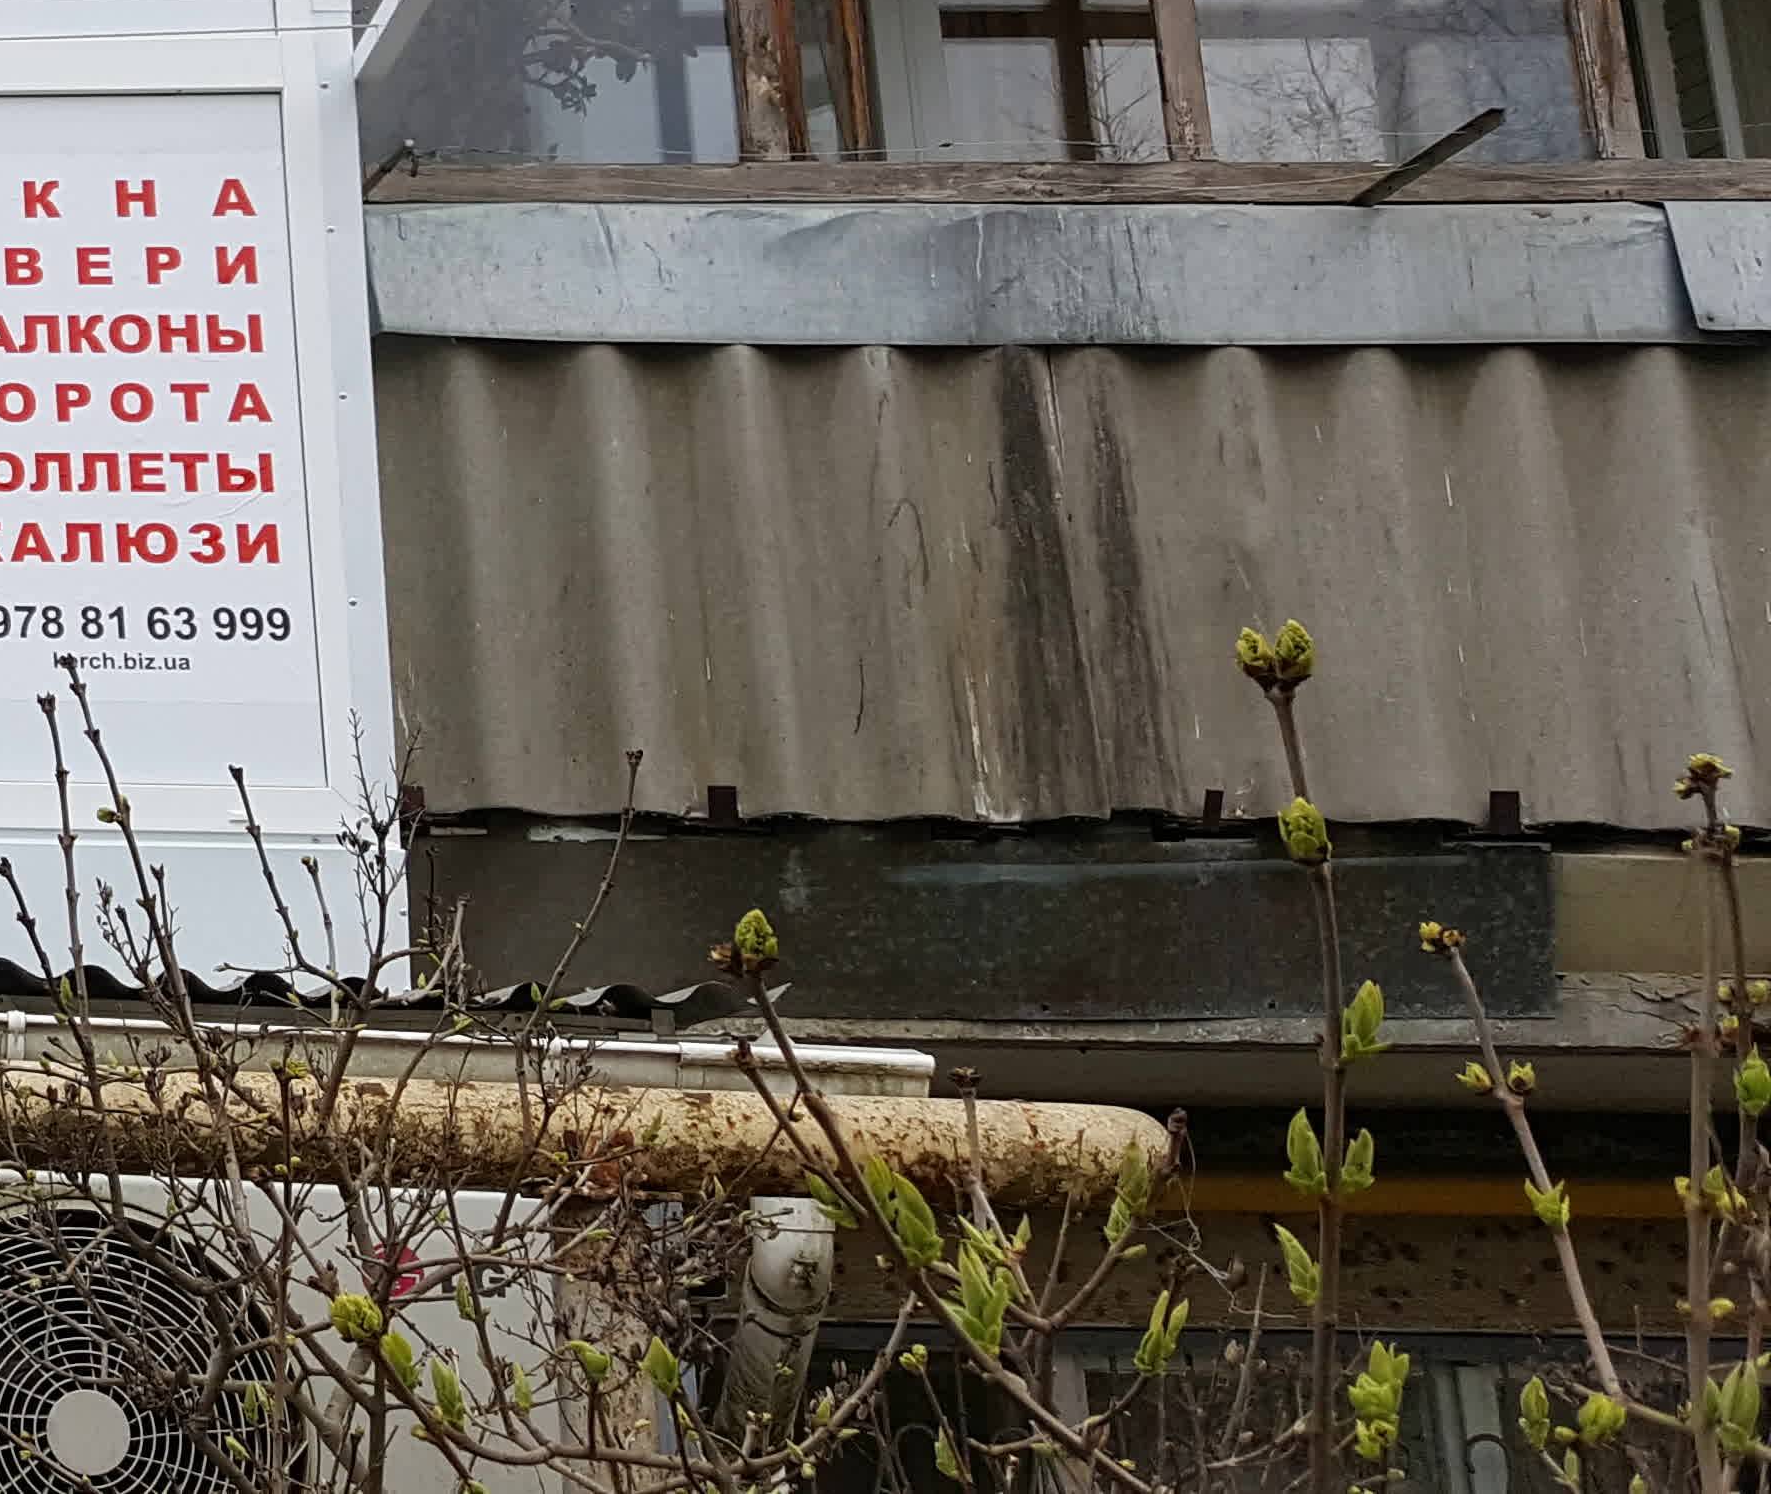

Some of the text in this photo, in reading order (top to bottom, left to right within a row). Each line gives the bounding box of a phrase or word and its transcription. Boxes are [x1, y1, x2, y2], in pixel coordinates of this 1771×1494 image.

[81, 605, 126, 639] 81
[146, 606, 198, 641] 63
[213, 607, 292, 642] 999
[53, 651, 191, 671] krch.biz.ua
